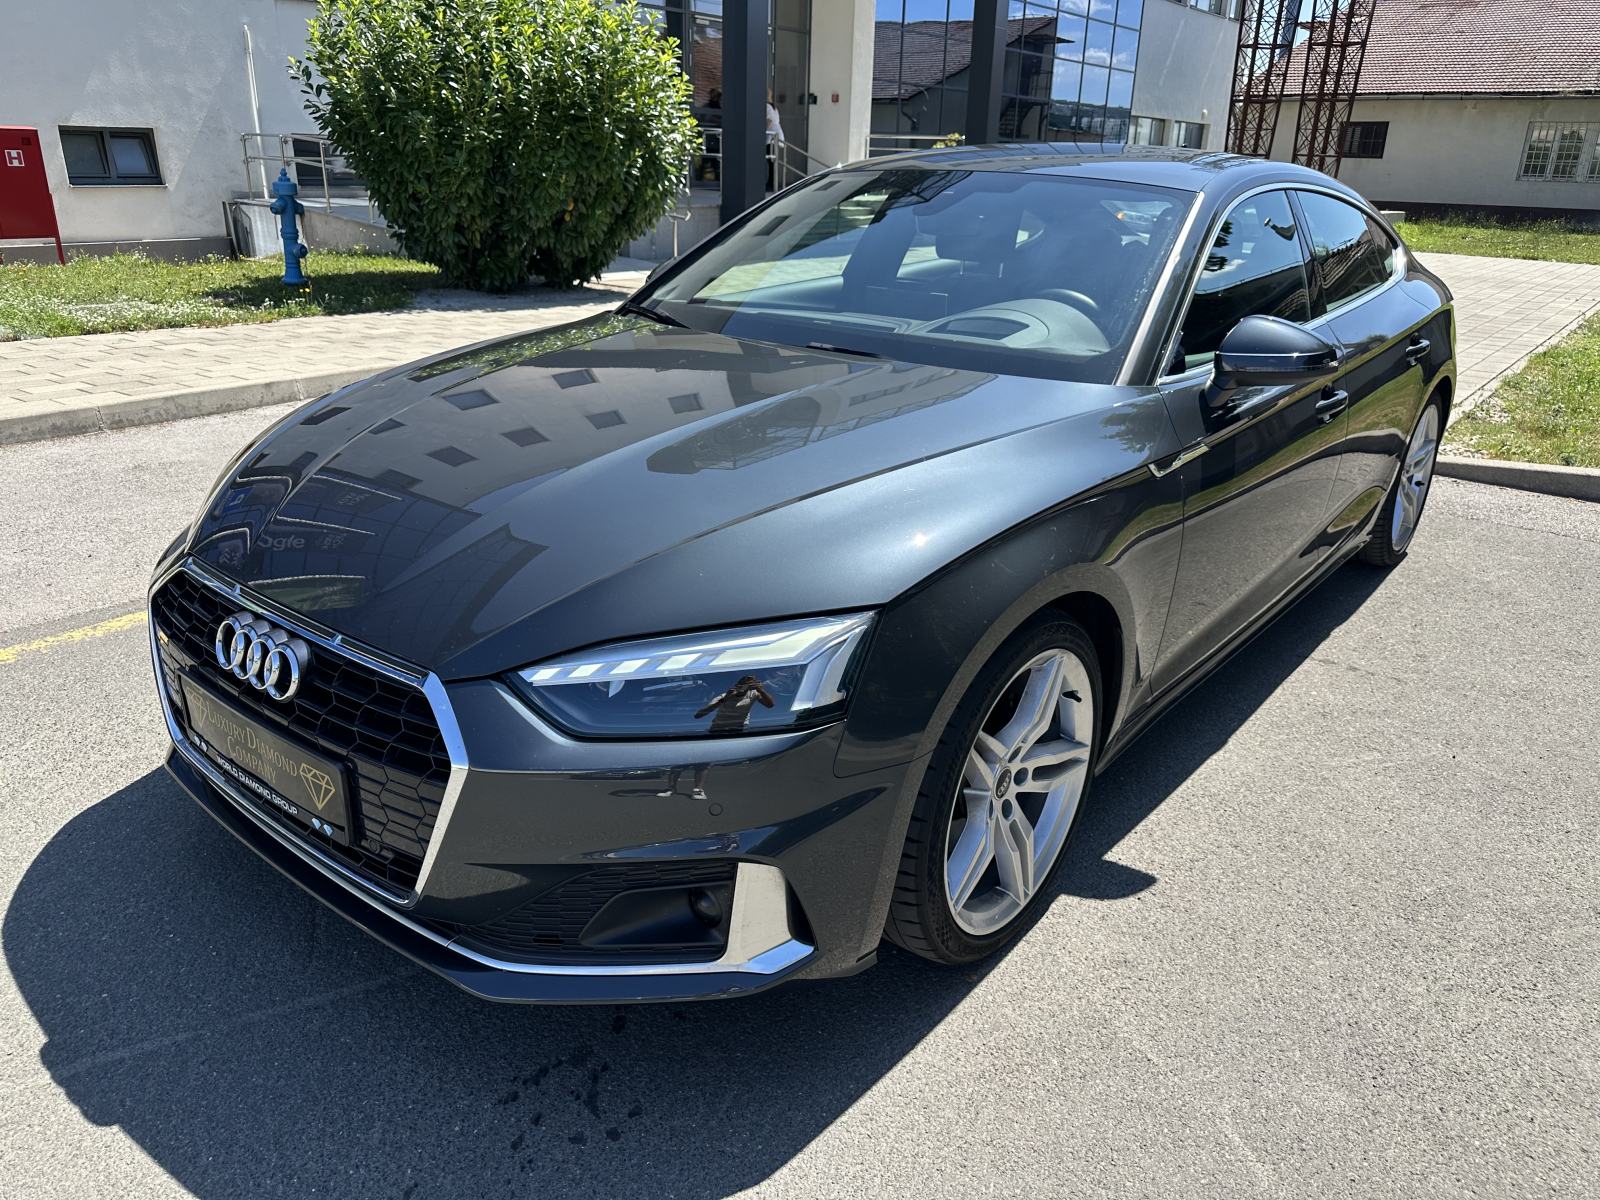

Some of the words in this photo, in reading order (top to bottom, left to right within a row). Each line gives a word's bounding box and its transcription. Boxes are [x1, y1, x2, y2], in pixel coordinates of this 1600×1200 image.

[6, 150, 24, 166] H
[207, 701, 245, 743] LUXURY
[246, 727, 297, 777] DIAMOND
[227, 736, 276, 784] COMPANY
[215, 754, 238, 777] WORLD
[239, 772, 271, 799] DIAMOND
[271, 794, 298, 815] GROUP
